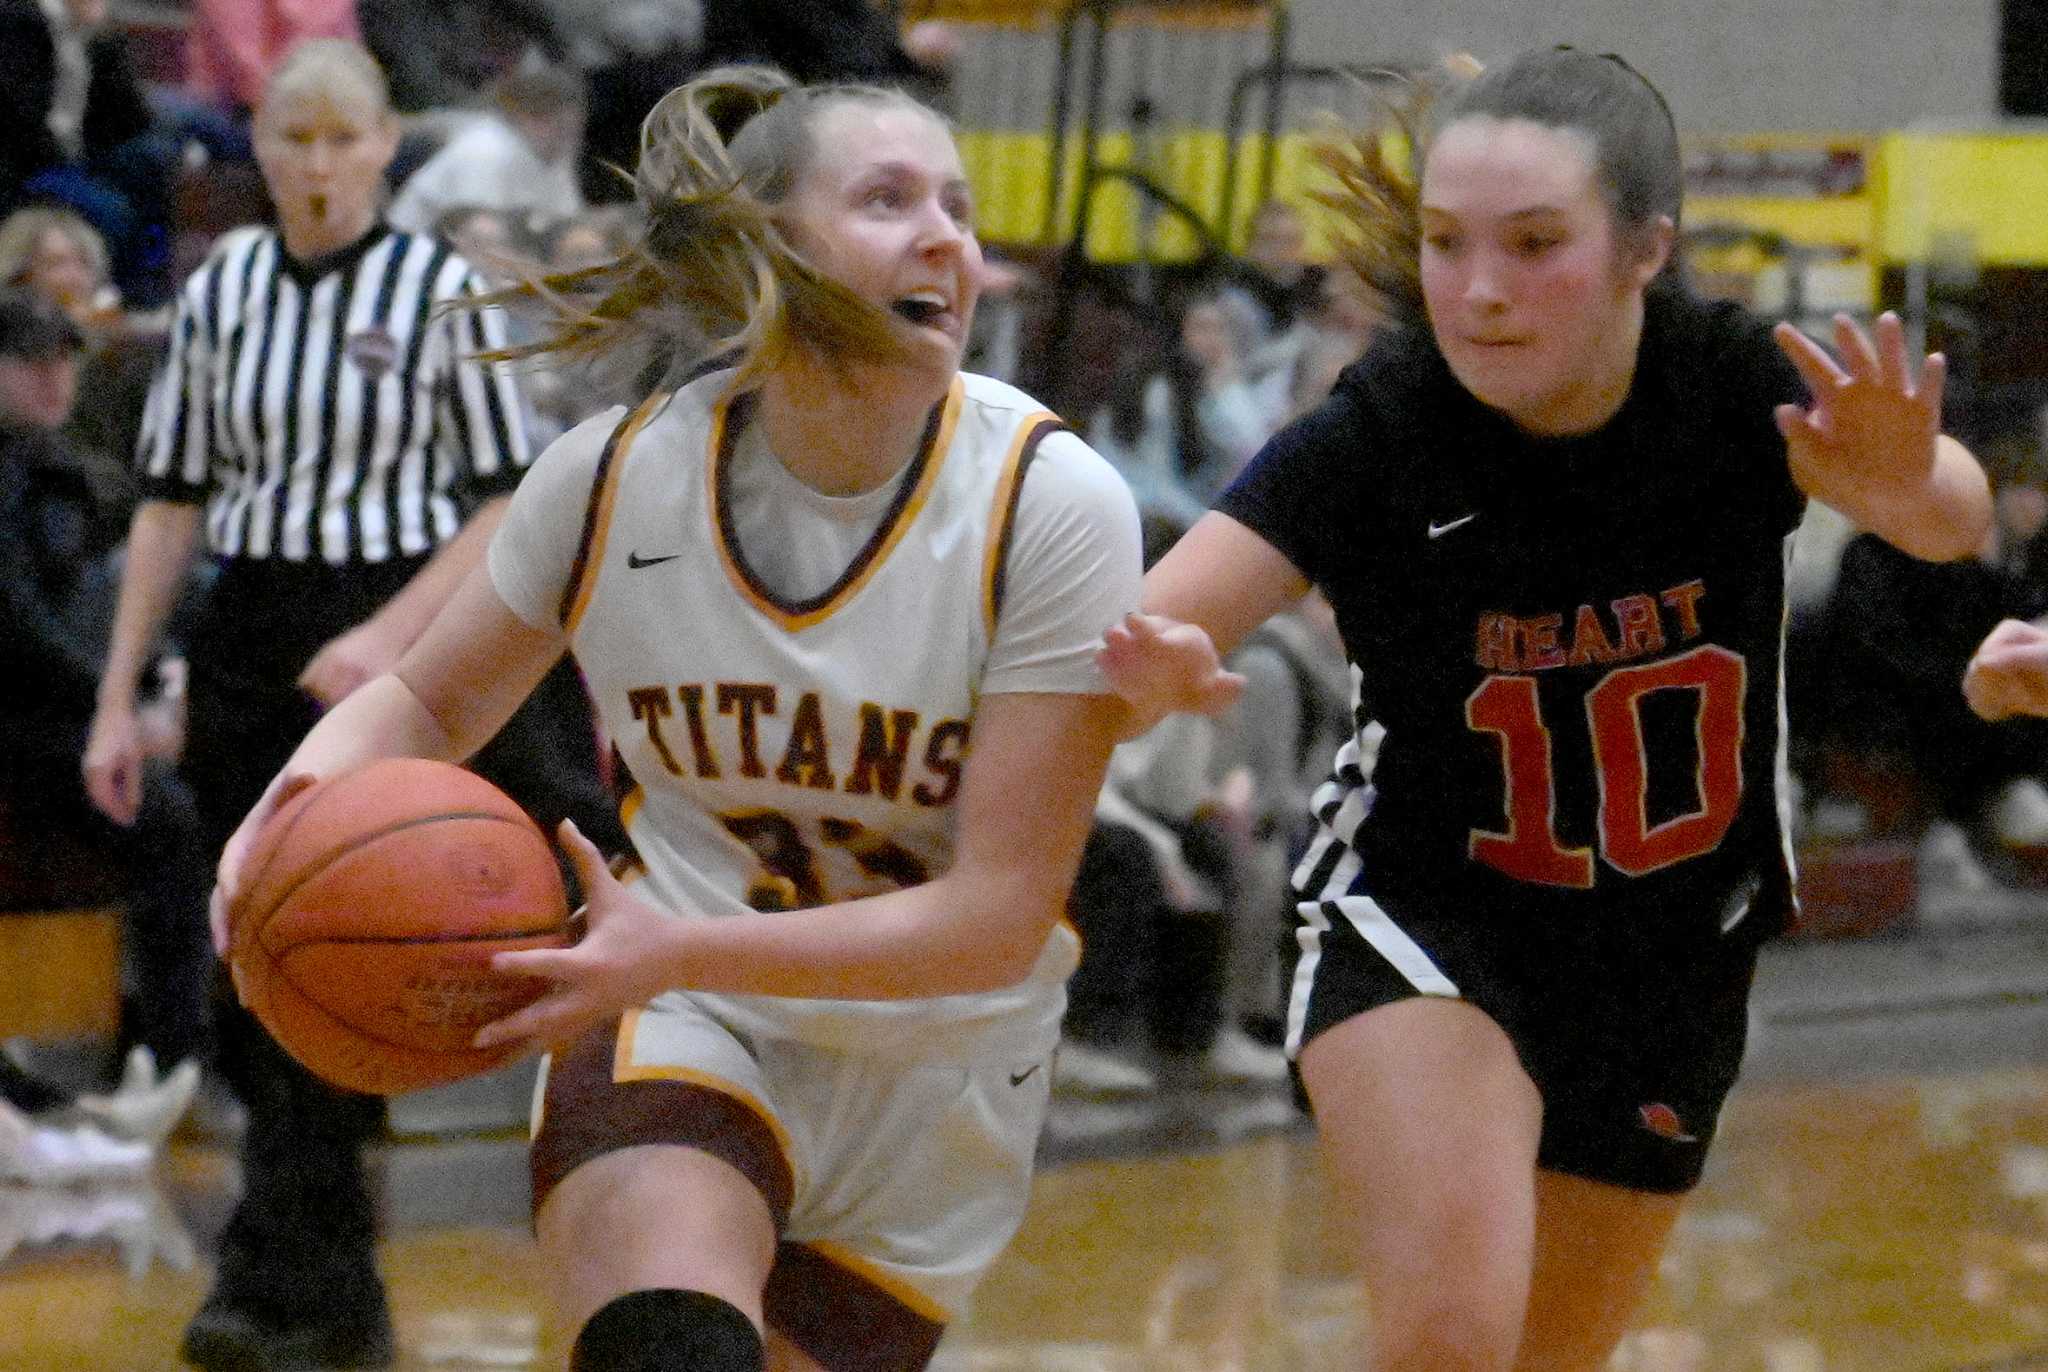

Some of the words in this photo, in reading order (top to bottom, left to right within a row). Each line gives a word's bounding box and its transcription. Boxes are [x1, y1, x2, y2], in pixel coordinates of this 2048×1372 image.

[1475, 578, 1706, 671] HEART
[627, 682, 974, 807] TITANS
[1465, 643, 1748, 888] 10
